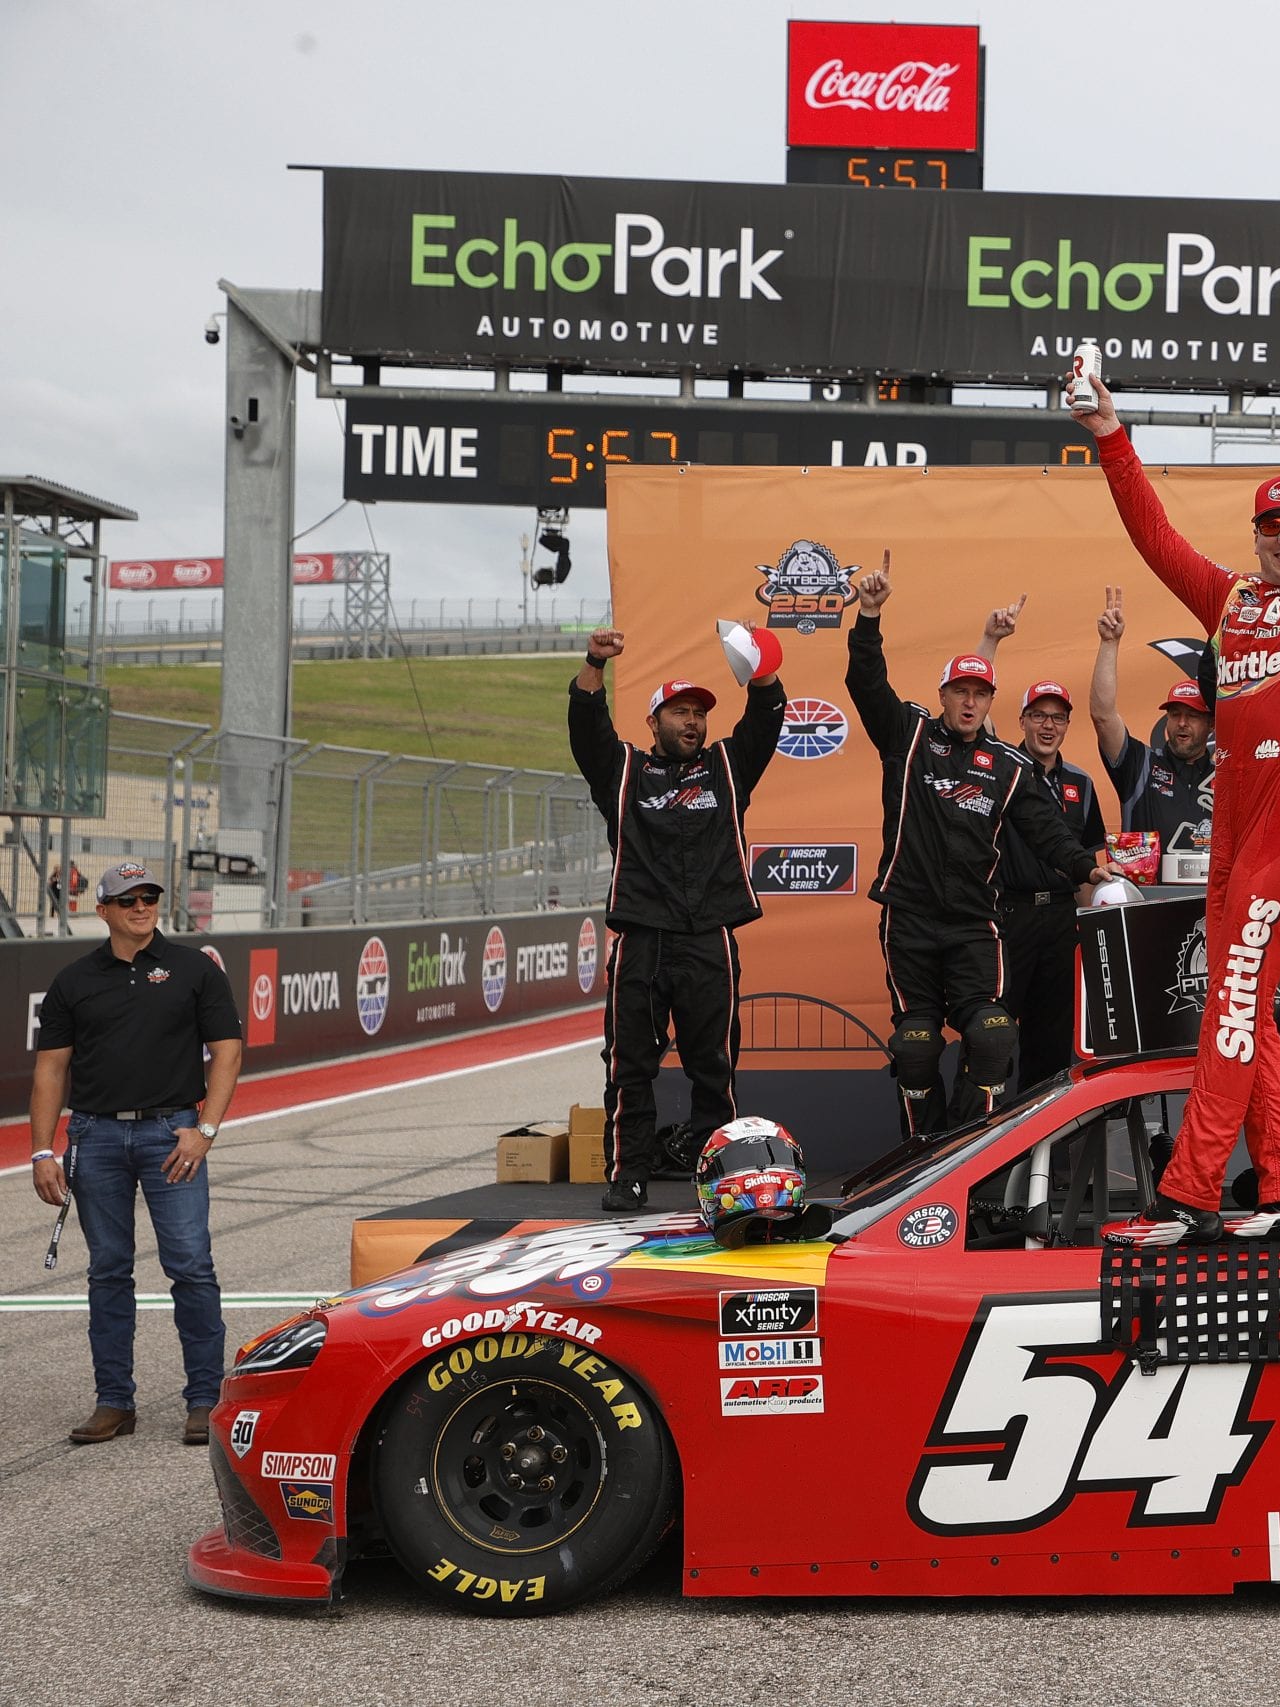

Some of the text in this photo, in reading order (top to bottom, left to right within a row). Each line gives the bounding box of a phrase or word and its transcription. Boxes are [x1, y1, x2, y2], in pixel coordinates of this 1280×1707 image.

[805, 59, 960, 112] Coca-Cola
[410, 212, 783, 301] EchoPark
[477, 315, 719, 346] AUTOMOTIVE
[352, 424, 478, 479] TIME
[780, 575, 837, 585] PIT BOSS
[770, 594, 845, 613] 250
[959, 803, 990, 817] RACING
[790, 849, 827, 859] NASCAR
[767, 860, 839, 884] xfinity
[790, 880, 820, 890] SERIES
[407, 932, 467, 993] EchoPark
[516, 942, 568, 984] PIT BOSS
[1096, 928, 1118, 1041] PIT BOSS
[1216, 898, 1280, 1063] Skittles
[281, 971, 340, 1015] TOYOTA
[416, 1002, 456, 1023] AUTOMOTIVE
[744, 1174, 782, 1190] Skittles
[907, 1206, 950, 1224] NASCAR
[904, 1228, 951, 1246] SALUTES
[757, 1293, 790, 1302] NASCAR
[736, 1304, 801, 1327] xfinity
[757, 1322, 784, 1331] SERIES
[725, 1341, 787, 1362] Mobil
[724, 1378, 819, 1400] ARP
[788, 1397, 822, 1406] products
[914, 1299, 1258, 1528] 54
[232, 1420, 254, 1445] 30
[264, 1454, 333, 1478] SIMPSON
[289, 1497, 329, 1509] SUNOCO
[427, 1557, 546, 1602] EAGLE
